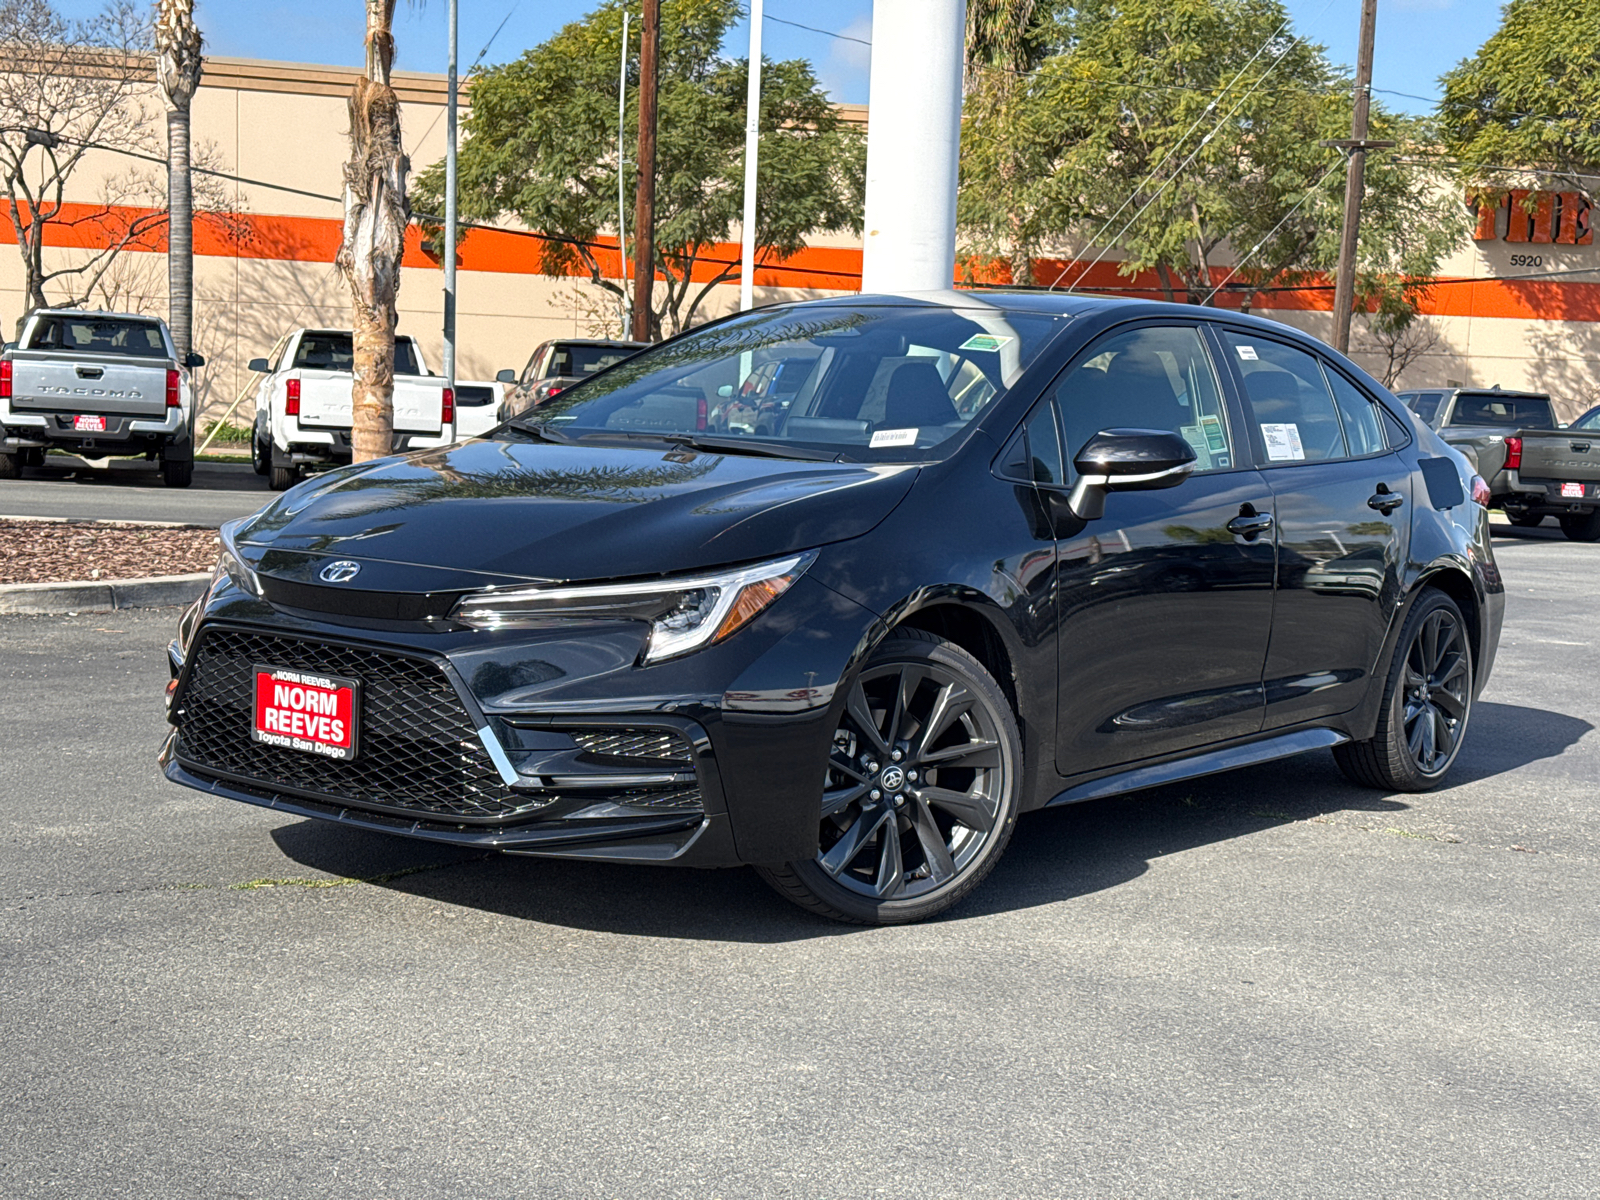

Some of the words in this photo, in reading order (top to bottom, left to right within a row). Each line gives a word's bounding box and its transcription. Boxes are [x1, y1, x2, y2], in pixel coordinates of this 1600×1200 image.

[1466, 187, 1594, 245] THE
[1510, 254, 1542, 267] 5920
[37, 385, 143, 399] TACOMA
[76, 422, 103, 430] REEVES
[276, 670, 300, 683] NORM
[301, 675, 331, 688] REEVES
[274, 685, 338, 717] NORM
[265, 707, 344, 743] REEVES
[257, 730, 291, 746] Toyota
[292, 738, 313, 751] San
[315, 742, 346, 759] Diego
